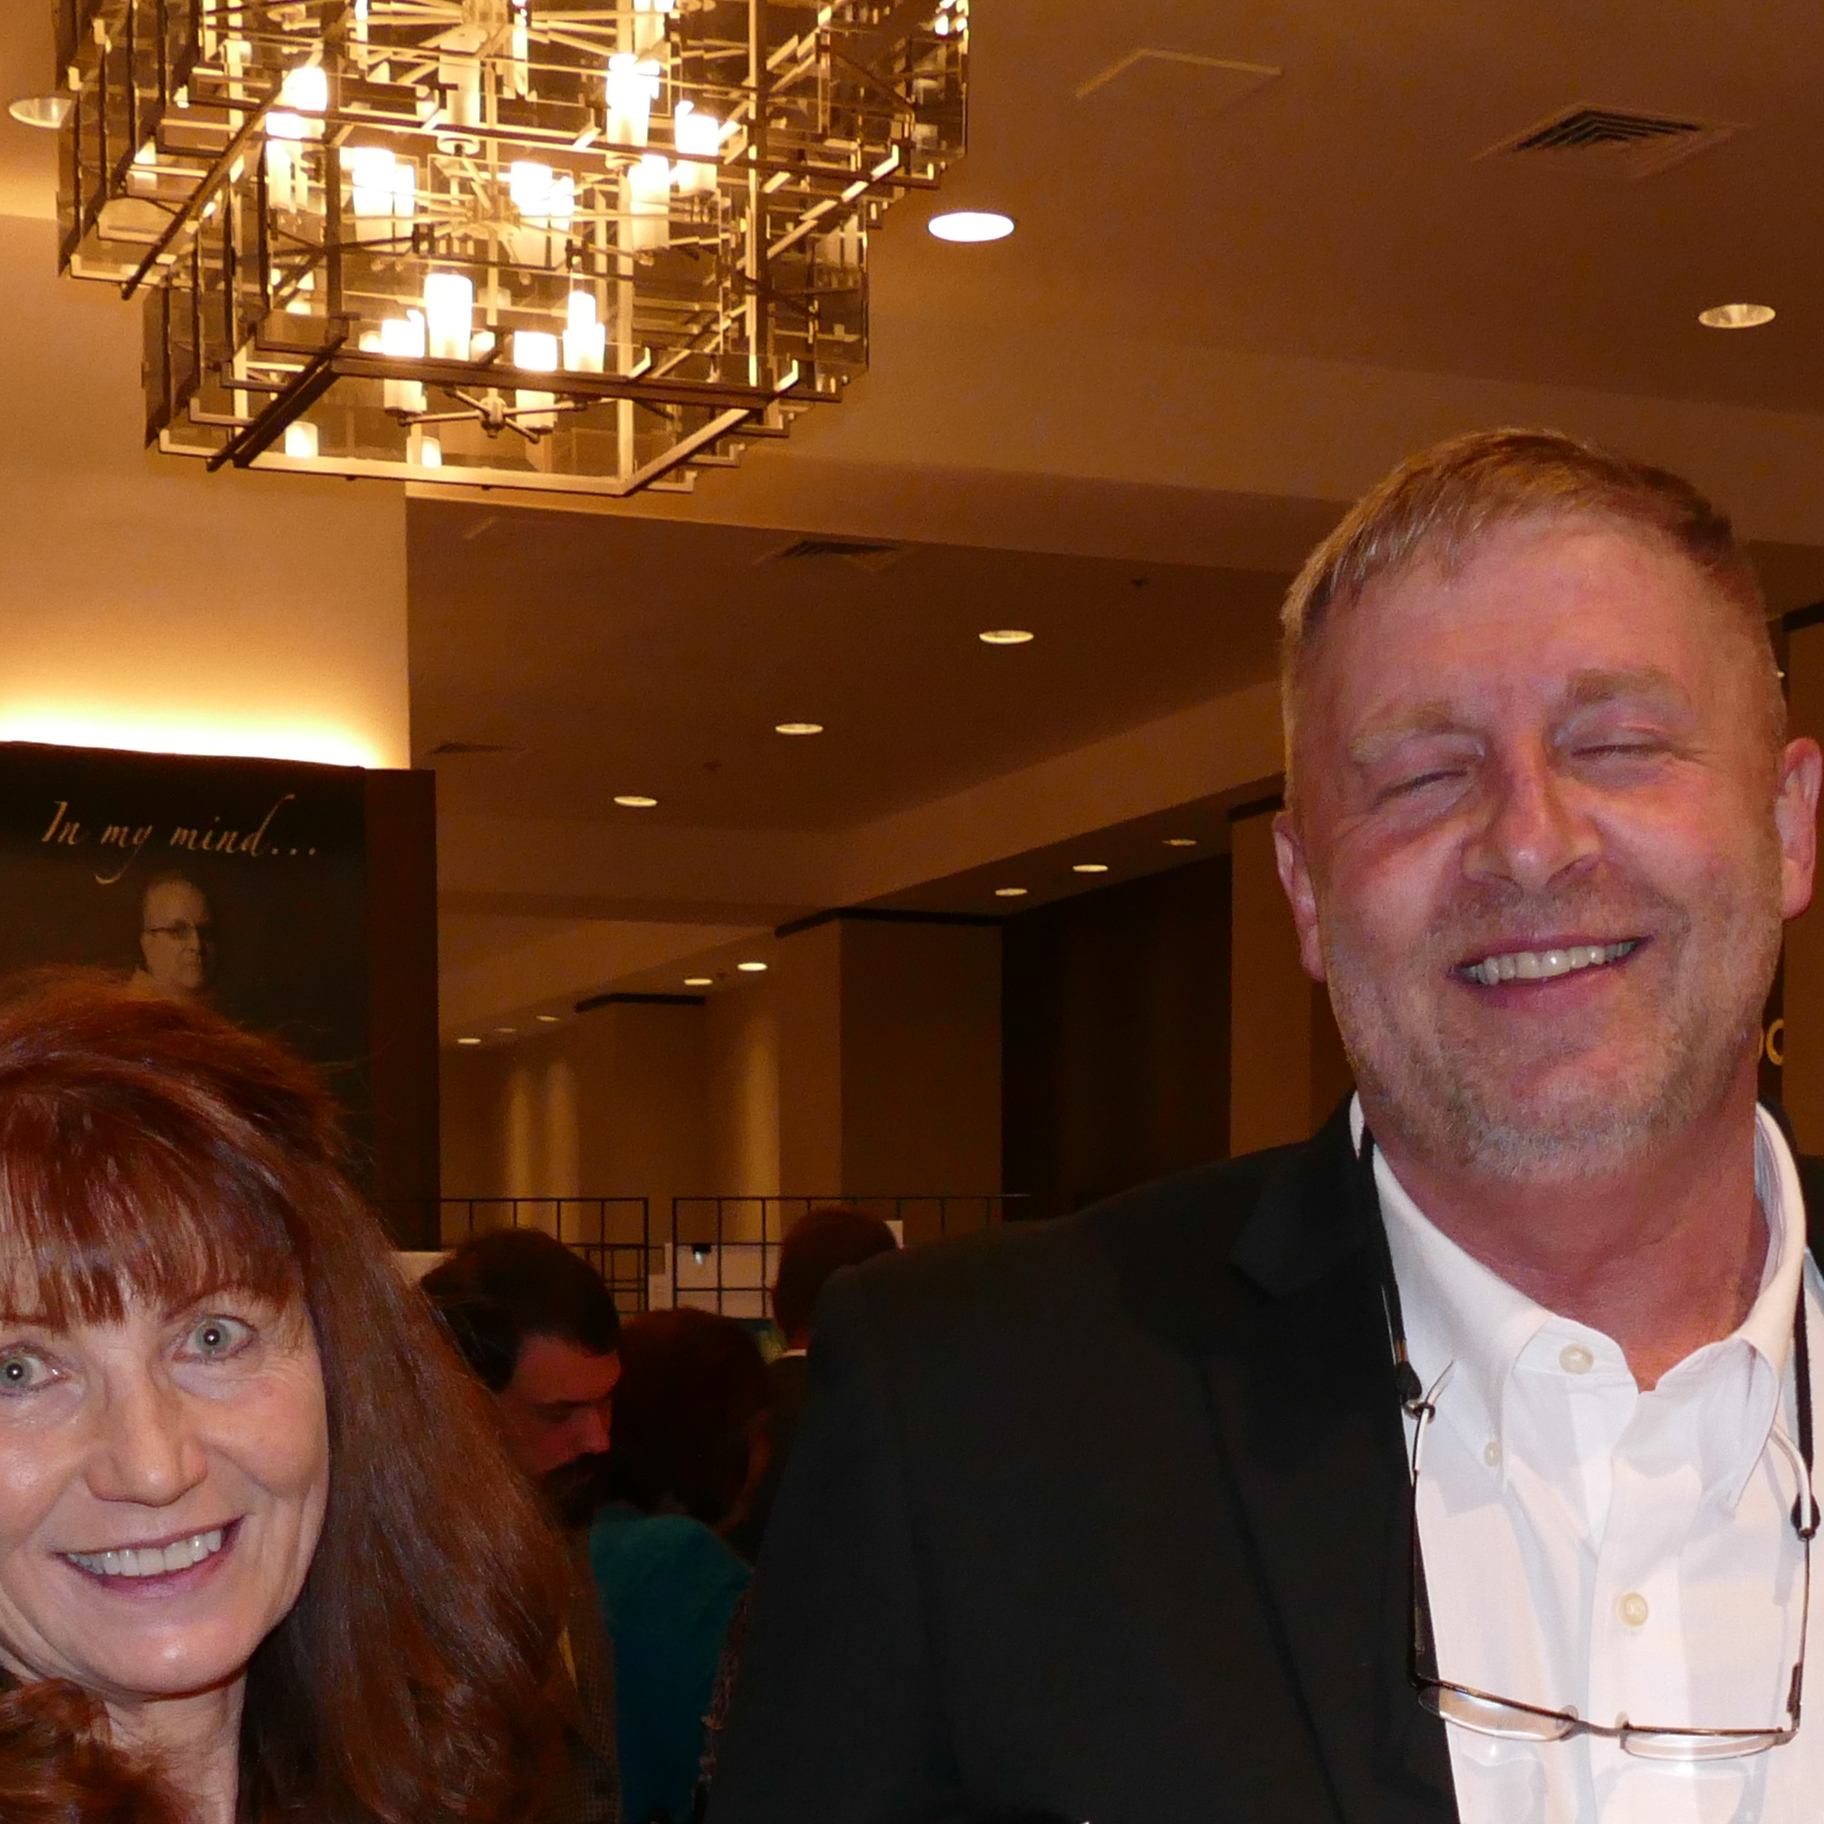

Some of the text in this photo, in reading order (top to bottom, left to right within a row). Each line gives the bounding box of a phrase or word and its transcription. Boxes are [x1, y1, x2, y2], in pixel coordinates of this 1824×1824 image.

[41, 793, 319, 885] In my mind...
